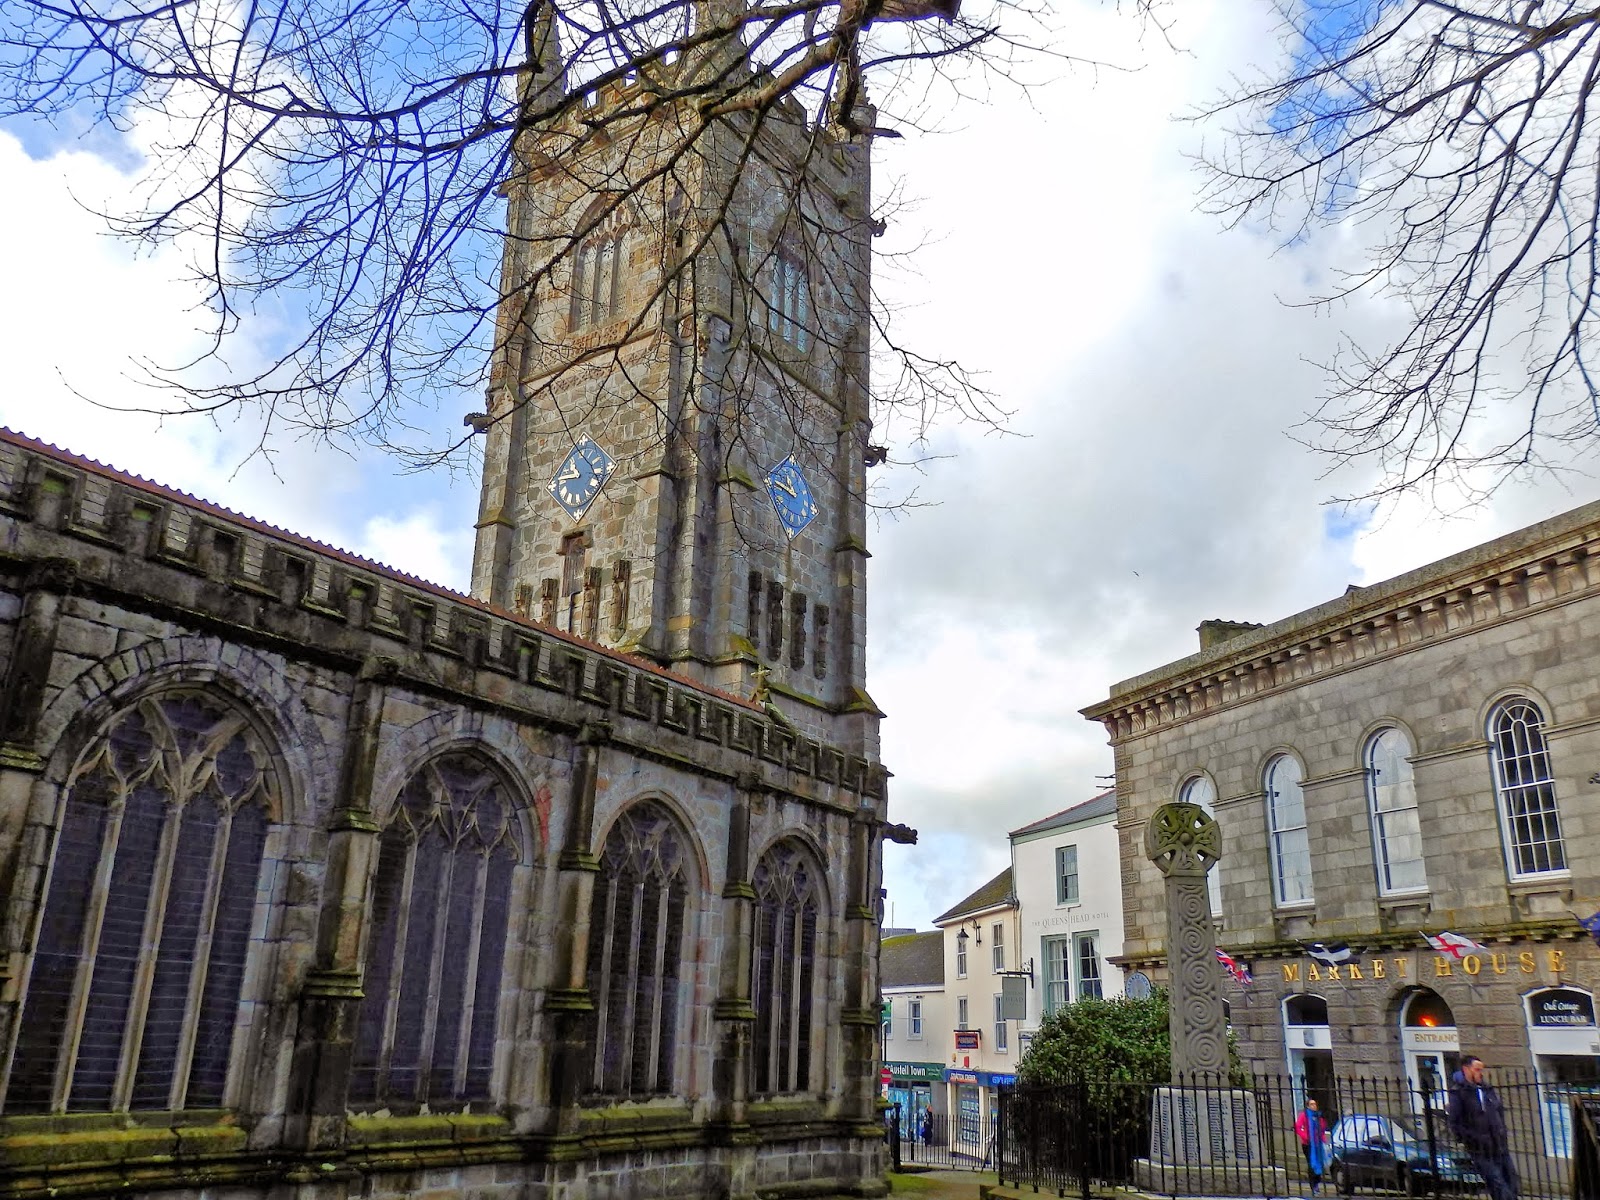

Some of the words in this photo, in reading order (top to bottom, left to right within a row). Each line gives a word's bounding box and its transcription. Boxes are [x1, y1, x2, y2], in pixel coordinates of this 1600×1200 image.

[1042, 916, 1068, 928] QUEENS
[1070, 913, 1090, 924] HEAD
[1282, 958, 1408, 982] MARKET
[1433, 949, 1567, 977] HOUSE
[1540, 1015, 1569, 1023] LUNCH
[1570, 1015, 1588, 1023] BAR
[910, 1065, 926, 1077] Town
